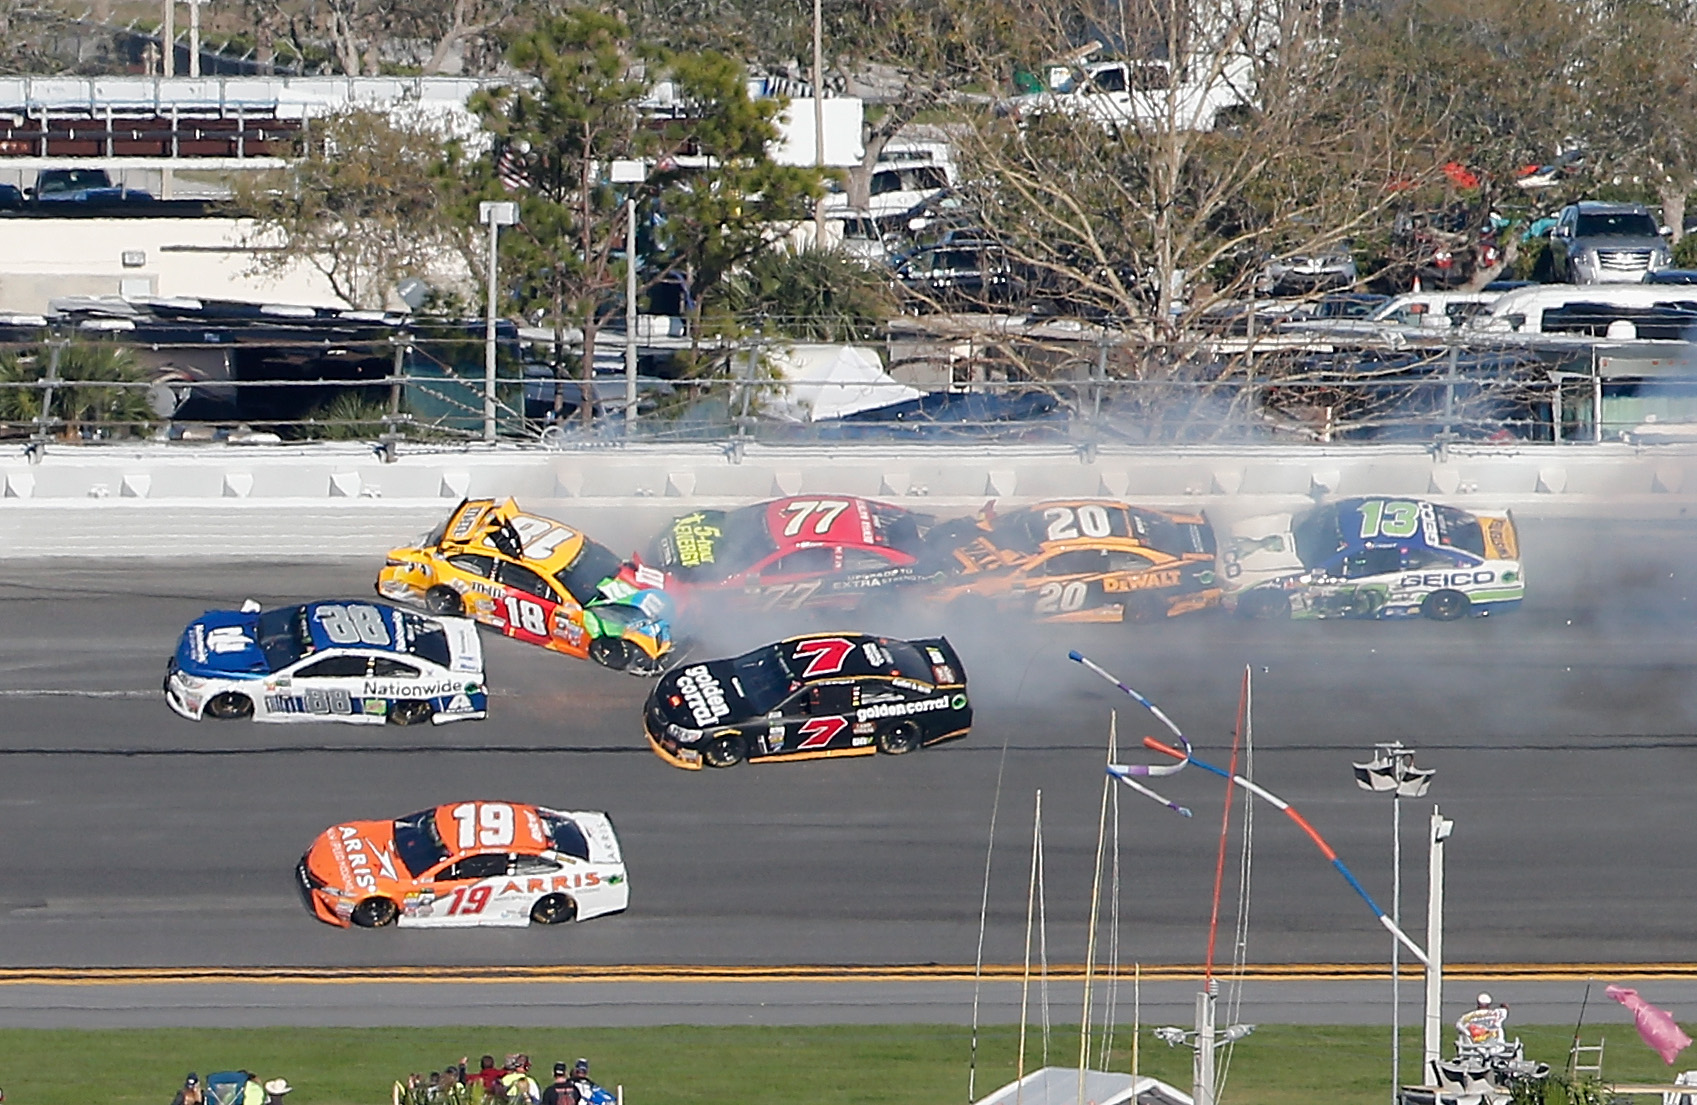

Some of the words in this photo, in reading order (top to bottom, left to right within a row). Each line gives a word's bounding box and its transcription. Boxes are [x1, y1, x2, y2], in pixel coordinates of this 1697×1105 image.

[784, 499, 850, 537] 77
[1045, 504, 1112, 541] 20
[1357, 500, 1420, 539] 13
[762, 578, 823, 612] 77
[832, 578, 881, 590] EXTRA
[1036, 581, 1088, 612] 20
[1400, 571, 1496, 588] GEICO
[313, 604, 391, 646] 88
[504, 596, 547, 636] 18
[792, 637, 857, 679] 7
[304, 688, 353, 715] 88
[363, 680, 463, 697] Nationwide
[676, 676, 721, 728] corral
[685, 664, 731, 719] golden
[856, 702, 908, 723] golden
[905, 694, 950, 715] corral
[797, 715, 849, 751] 7
[452, 801, 515, 850] 19
[338, 826, 377, 893] ARRIS
[445, 885, 492, 916] 19
[498, 871, 602, 896] ARRIS
